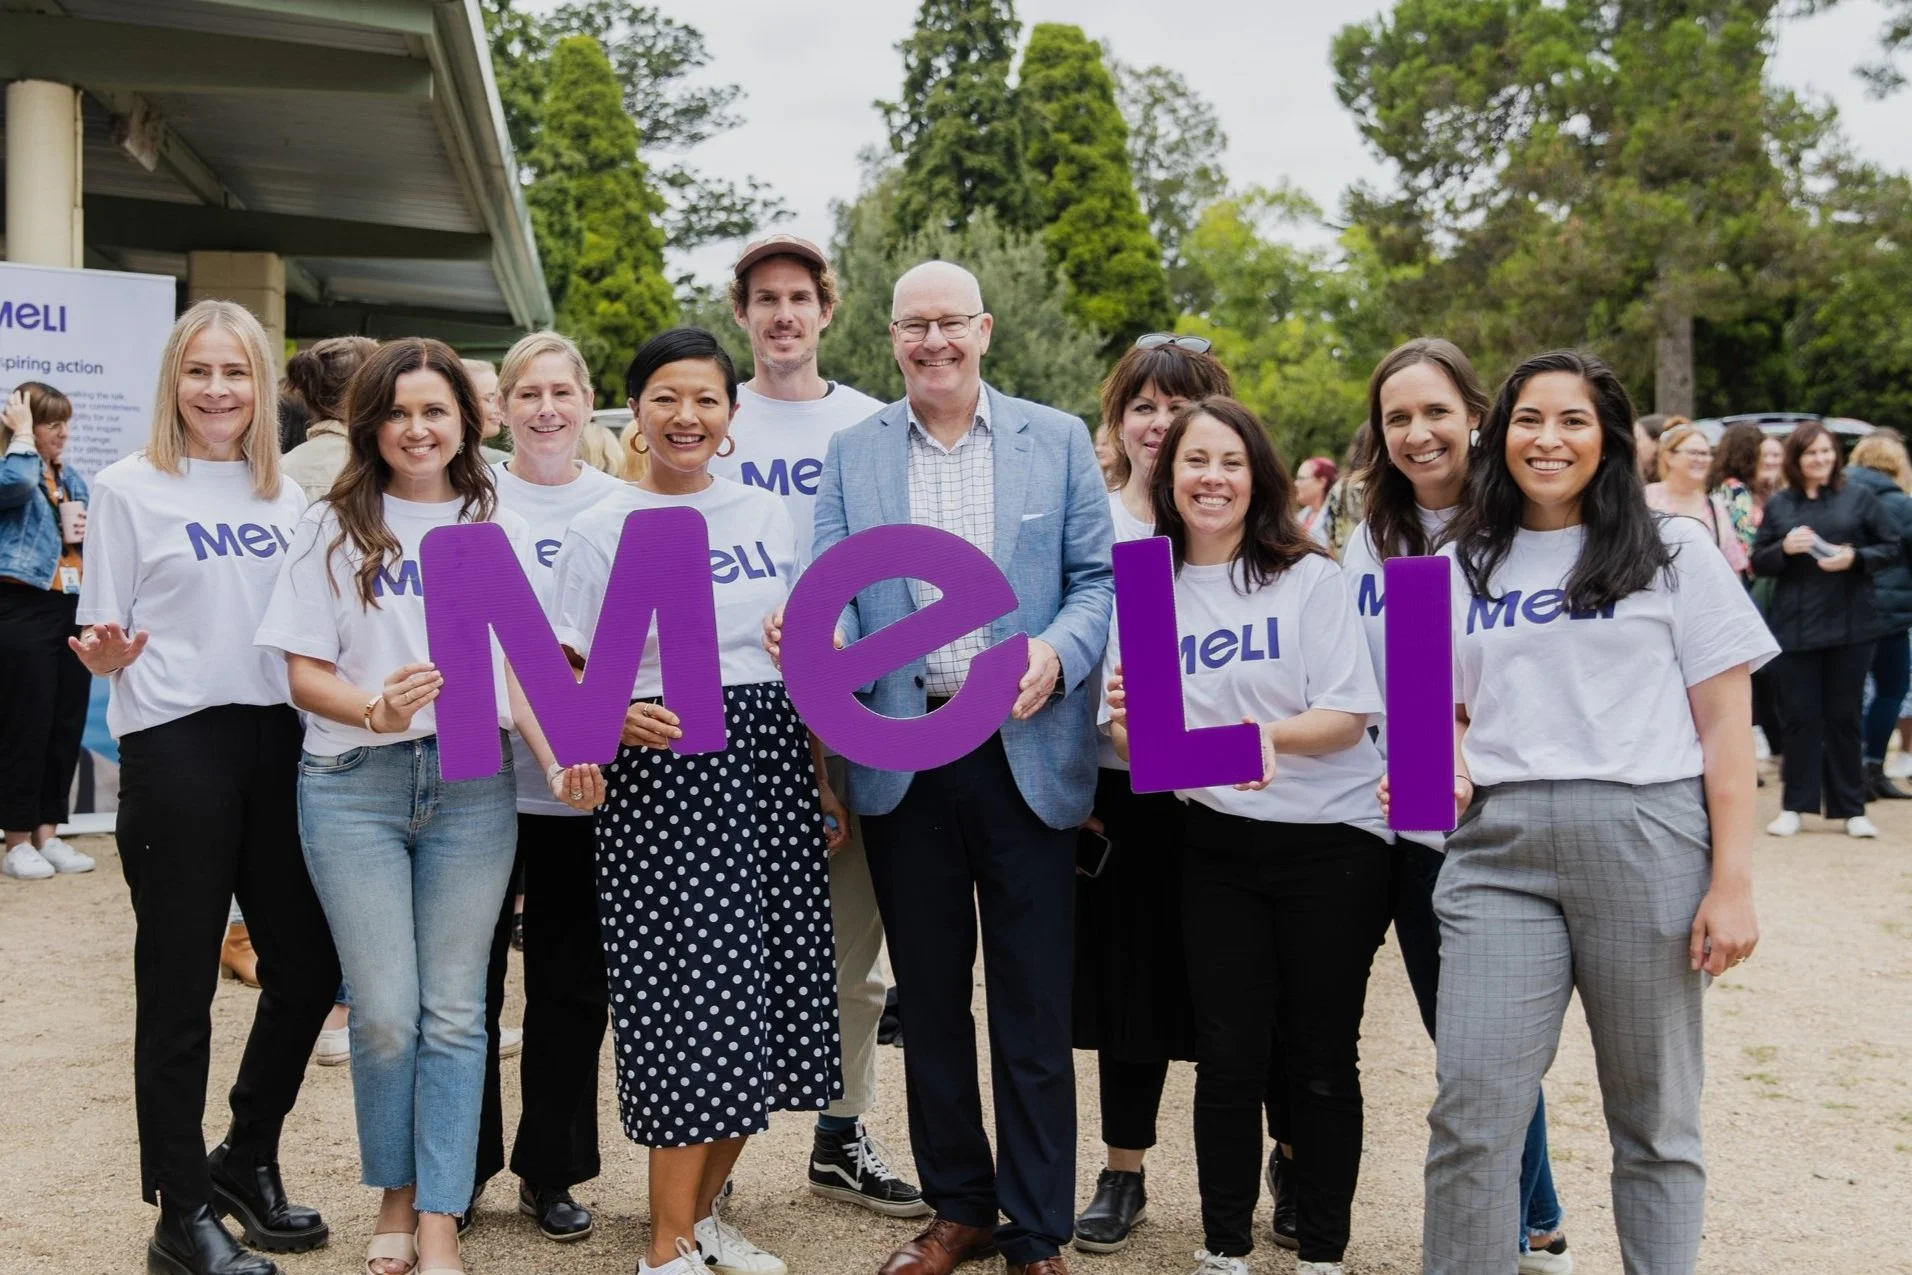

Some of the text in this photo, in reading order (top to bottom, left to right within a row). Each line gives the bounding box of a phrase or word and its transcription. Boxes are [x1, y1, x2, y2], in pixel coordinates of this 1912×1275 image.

[56, 359, 103, 375] action
[741, 458, 824, 496] Me
[709, 541, 777, 584] eLI
[420, 506, 1456, 833] MeLI
